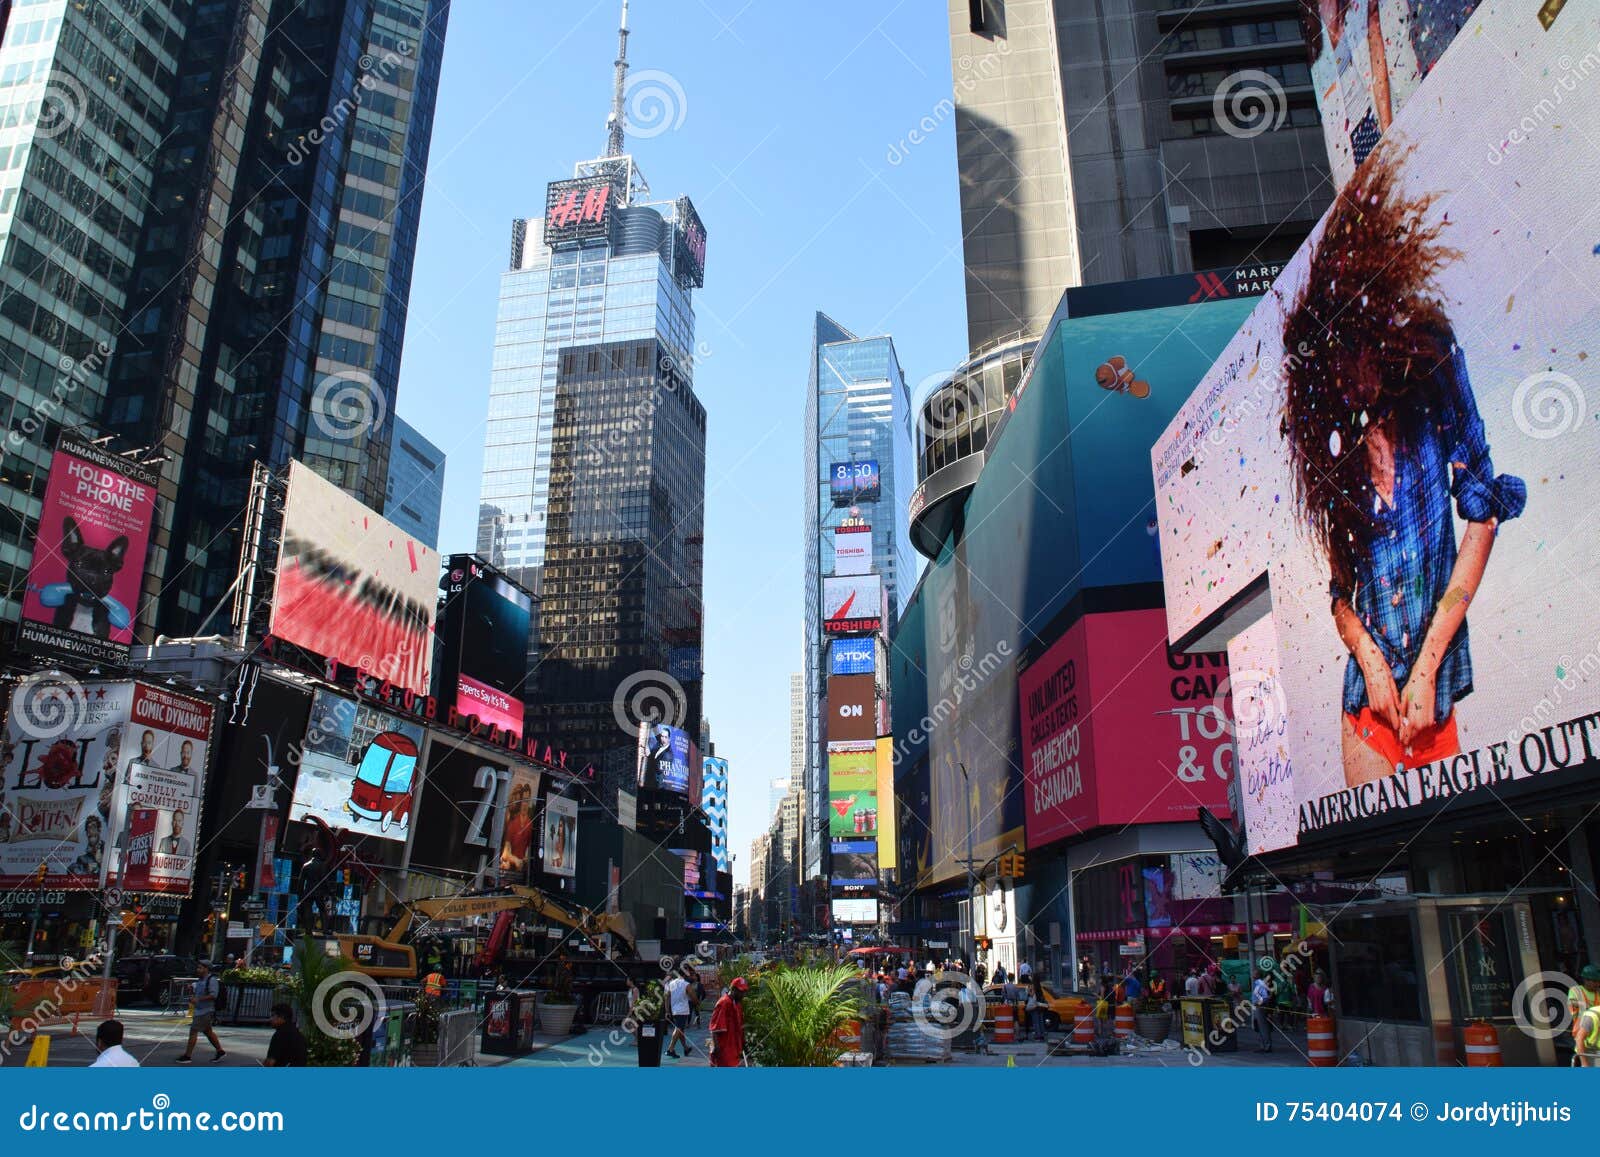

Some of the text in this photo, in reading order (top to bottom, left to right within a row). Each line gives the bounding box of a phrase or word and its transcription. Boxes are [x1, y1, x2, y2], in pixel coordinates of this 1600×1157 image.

[1236, 264, 1284, 280] MARR
[67, 460, 145, 502] HOLD THE
[837, 463, 872, 480] 8:50
[76, 481, 133, 513] PHONE
[450, 585, 462, 593] LG
[825, 619, 881, 632] TOSHIBA
[21, 628, 129, 663] HUMANEWATCH.ORG
[845, 650, 872, 662] TDK
[1028, 658, 1076, 721] UNLIMITED
[136, 698, 165, 721] COMIC
[840, 704, 863, 717] ON
[1172, 704, 1227, 741] TO
[425, 695, 568, 769] BROADWAY
[1032, 724, 1080, 780] TO MEXICO
[1177, 745, 1206, 783] &
[130, 790, 190, 811] COMMITTED
[147, 783, 177, 797] FULLY
[1041, 762, 1083, 811] CANADA
[1300, 771, 1408, 833] AMERICAN
[1417, 741, 1513, 801] EAGLE
